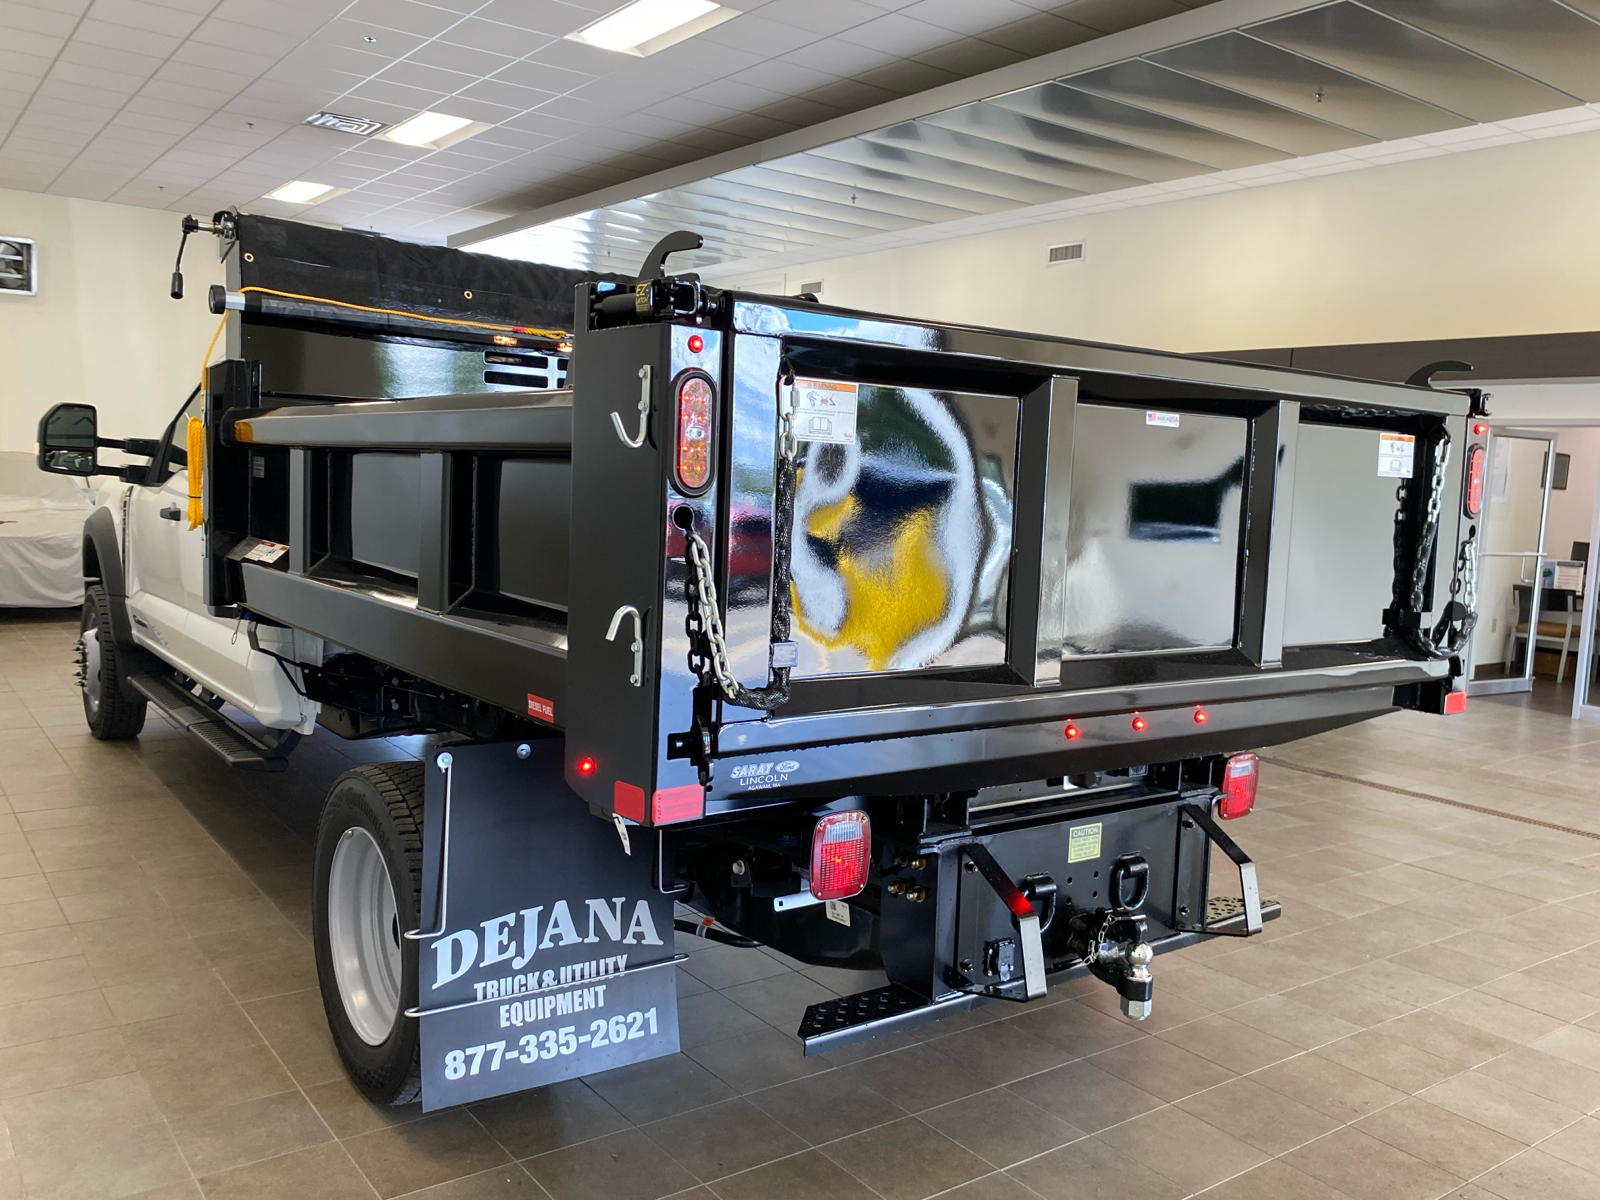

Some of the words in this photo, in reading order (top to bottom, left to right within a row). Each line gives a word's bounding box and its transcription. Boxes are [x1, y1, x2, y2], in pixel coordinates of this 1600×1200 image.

[812, 383, 837, 391] WARNING
[528, 699, 542, 713] DIESEL
[542, 704, 553, 717] FUEL
[730, 762, 774, 779] SARAT
[778, 761, 797, 771] Ford
[740, 773, 788, 786] LINCOLN
[1072, 826, 1099, 838] CAUTION
[431, 897, 664, 990] DEJANA
[473, 971, 540, 1001] TRUCK
[541, 969, 558, 990] &
[559, 954, 628, 987] UTILITY
[500, 984, 606, 1028] EQUIPMENT
[444, 1007, 658, 1080] 877-335-2621
